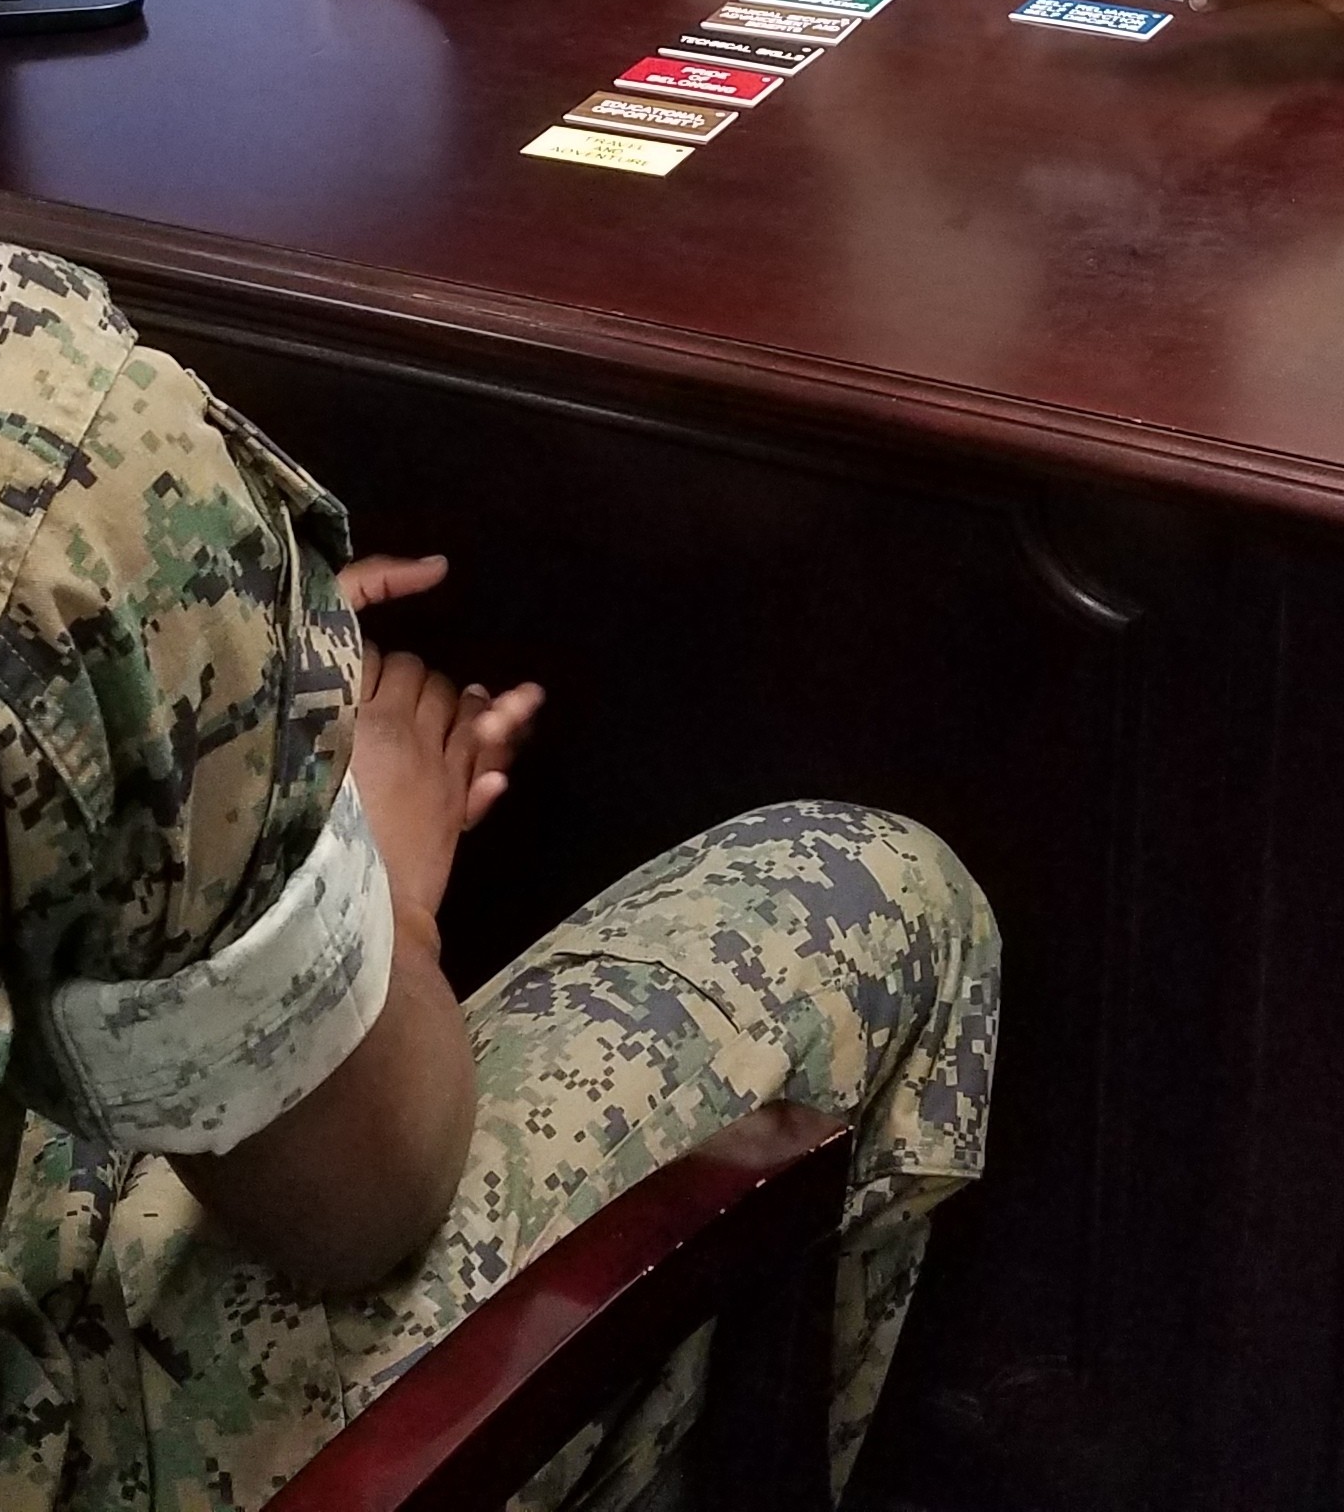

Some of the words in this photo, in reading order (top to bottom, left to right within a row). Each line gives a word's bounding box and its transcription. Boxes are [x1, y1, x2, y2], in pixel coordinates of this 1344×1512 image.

[679, 35, 752, 54] TECHNICAL
[755, 47, 806, 62] SKILLS
[681, 66, 732, 80] PRIDE
[646, 74, 737, 95] BELONGING
[591, 105, 706, 128] OPPORTUNITY
[600, 99, 704, 121] EDUCATIONAL
[585, 135, 644, 151] TRAVEL
[592, 145, 624, 154] AND
[550, 145, 650, 167] ADVENTURE
